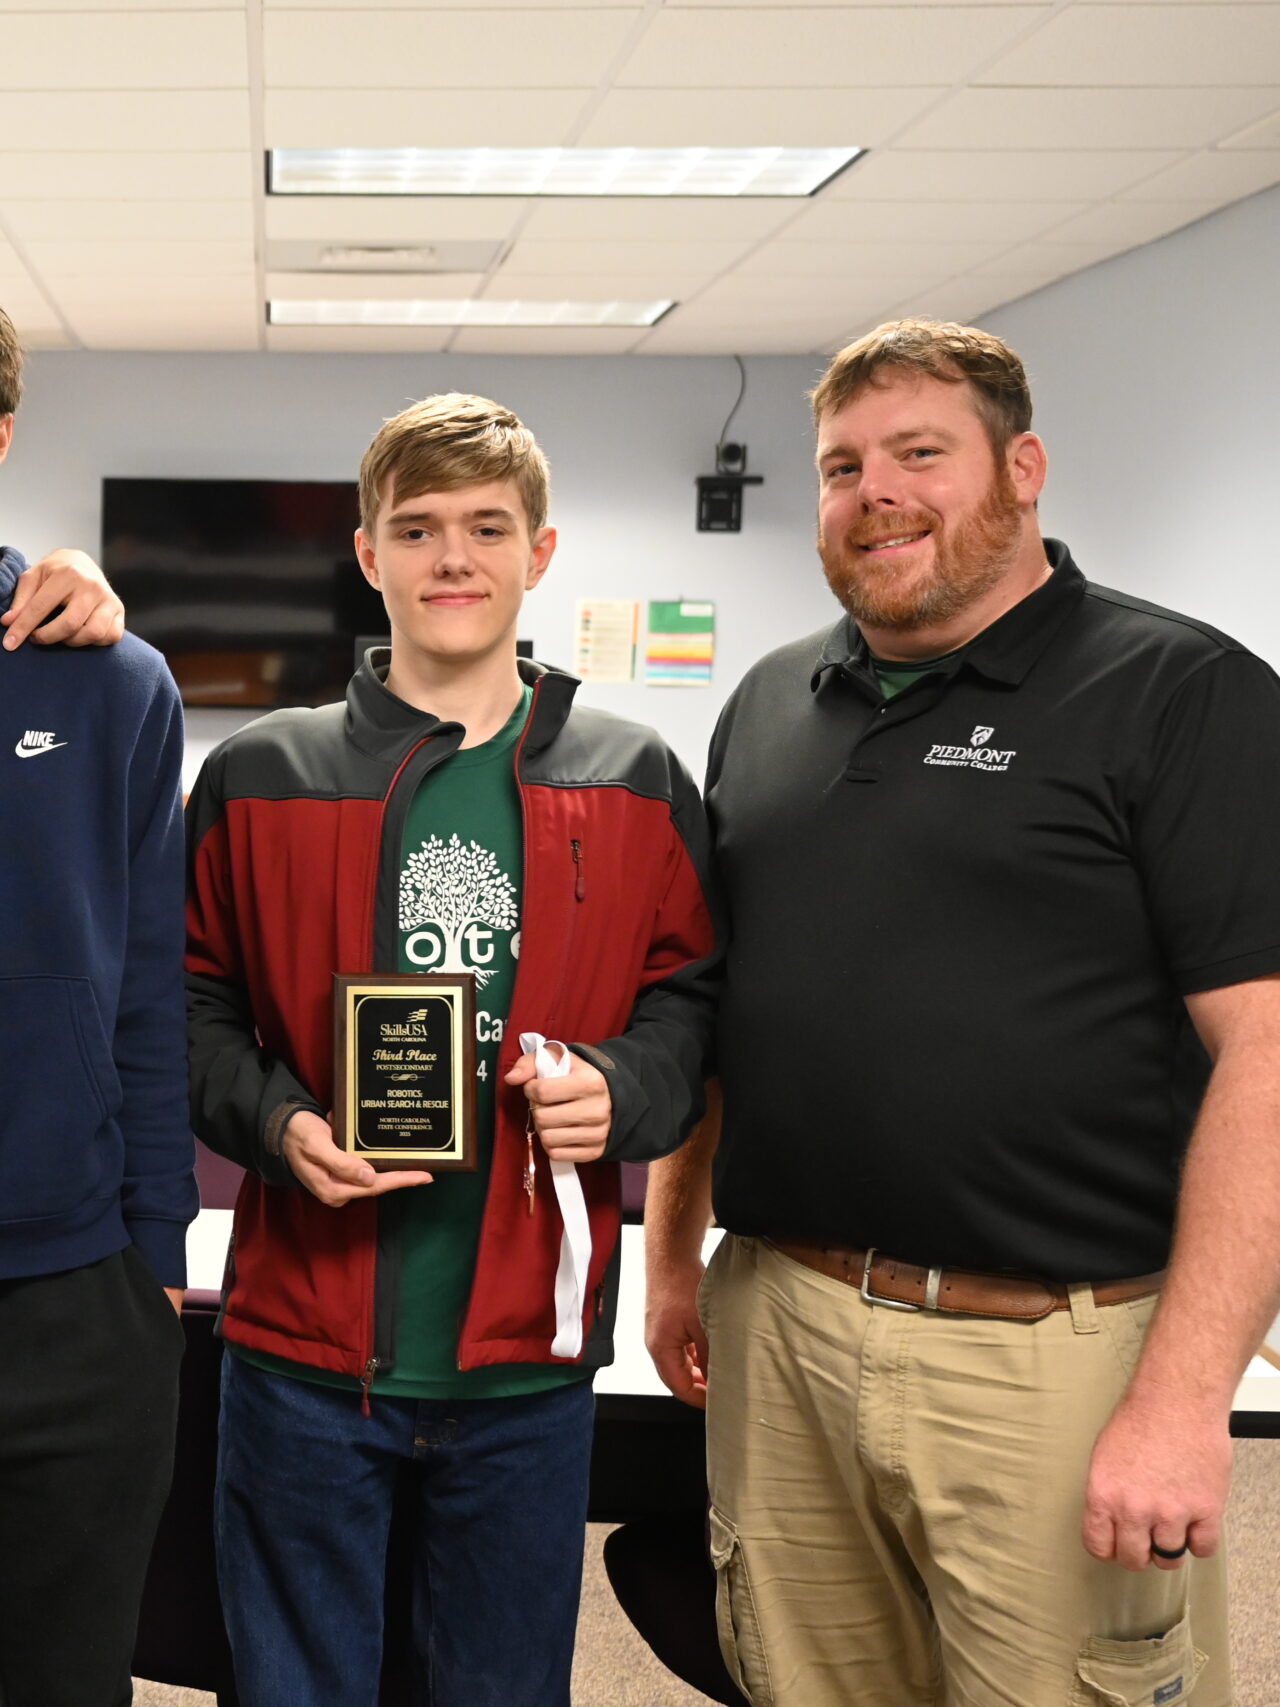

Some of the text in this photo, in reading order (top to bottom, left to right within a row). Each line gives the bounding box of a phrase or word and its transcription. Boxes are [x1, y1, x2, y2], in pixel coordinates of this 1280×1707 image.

[22, 730, 56, 747] NIKE
[925, 744, 1017, 764] PIEDMONT
[379, 1023, 428, 1036] SkillsUSA
[475, 1010, 508, 1043] Ca
[371, 1049, 438, 1061] Third Place
[386, 1089, 424, 1098] ROBOTICS:
[361, 1100, 449, 1109] URBAN SEARCH & RESCUE
